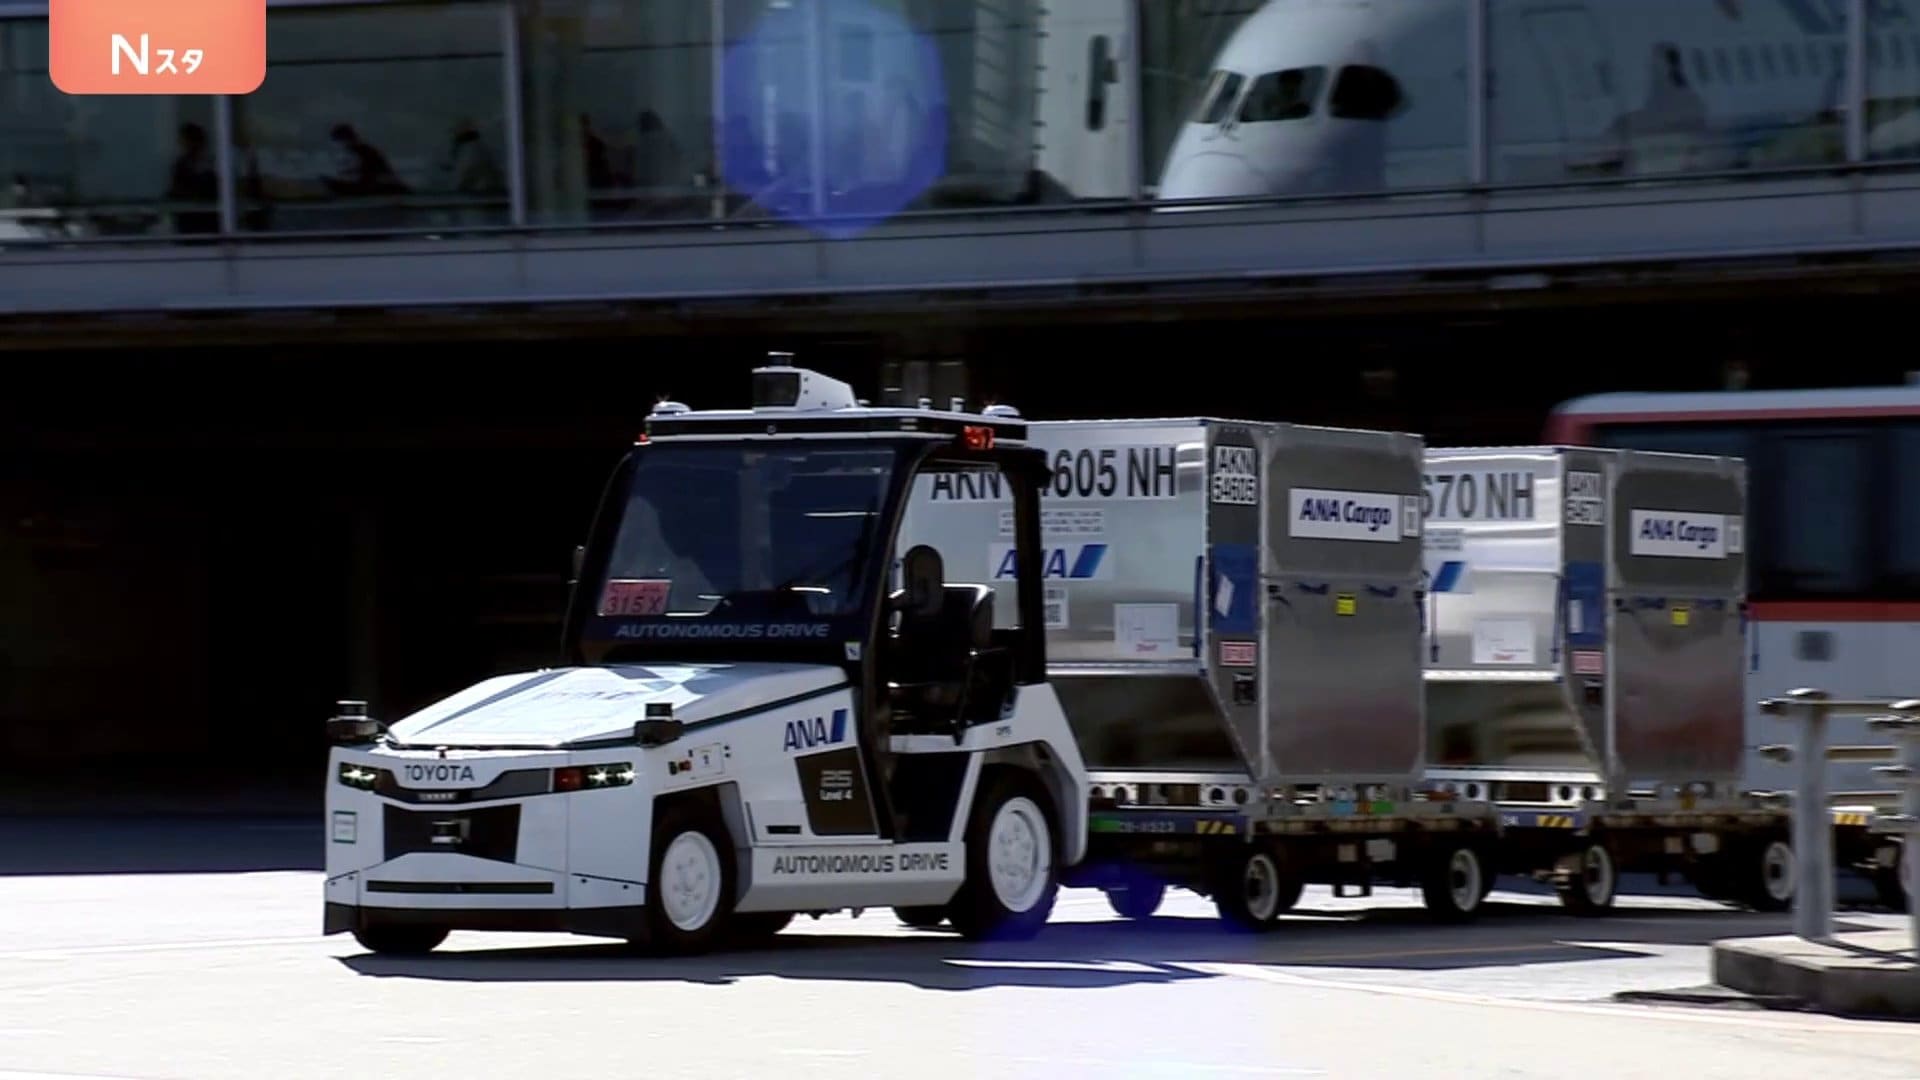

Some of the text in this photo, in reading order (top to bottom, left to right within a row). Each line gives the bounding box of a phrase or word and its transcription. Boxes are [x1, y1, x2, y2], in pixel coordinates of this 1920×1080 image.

[1041, 448, 1118, 498] 605
[1126, 447, 1176, 498] NH
[1485, 471, 1535, 519] NH
[1299, 496, 1341, 522] ANA
[1343, 499, 1392, 532] Cargo
[1638, 517, 1720, 549] ANA Cargo
[994, 548, 1068, 579] AA
[615, 623, 830, 638] AUTONOMOUS DRIVE
[783, 715, 831, 751] ANA
[404, 764, 476, 783] TOYOTA
[772, 852, 949, 875] AUTONOMOUS DRIVE
